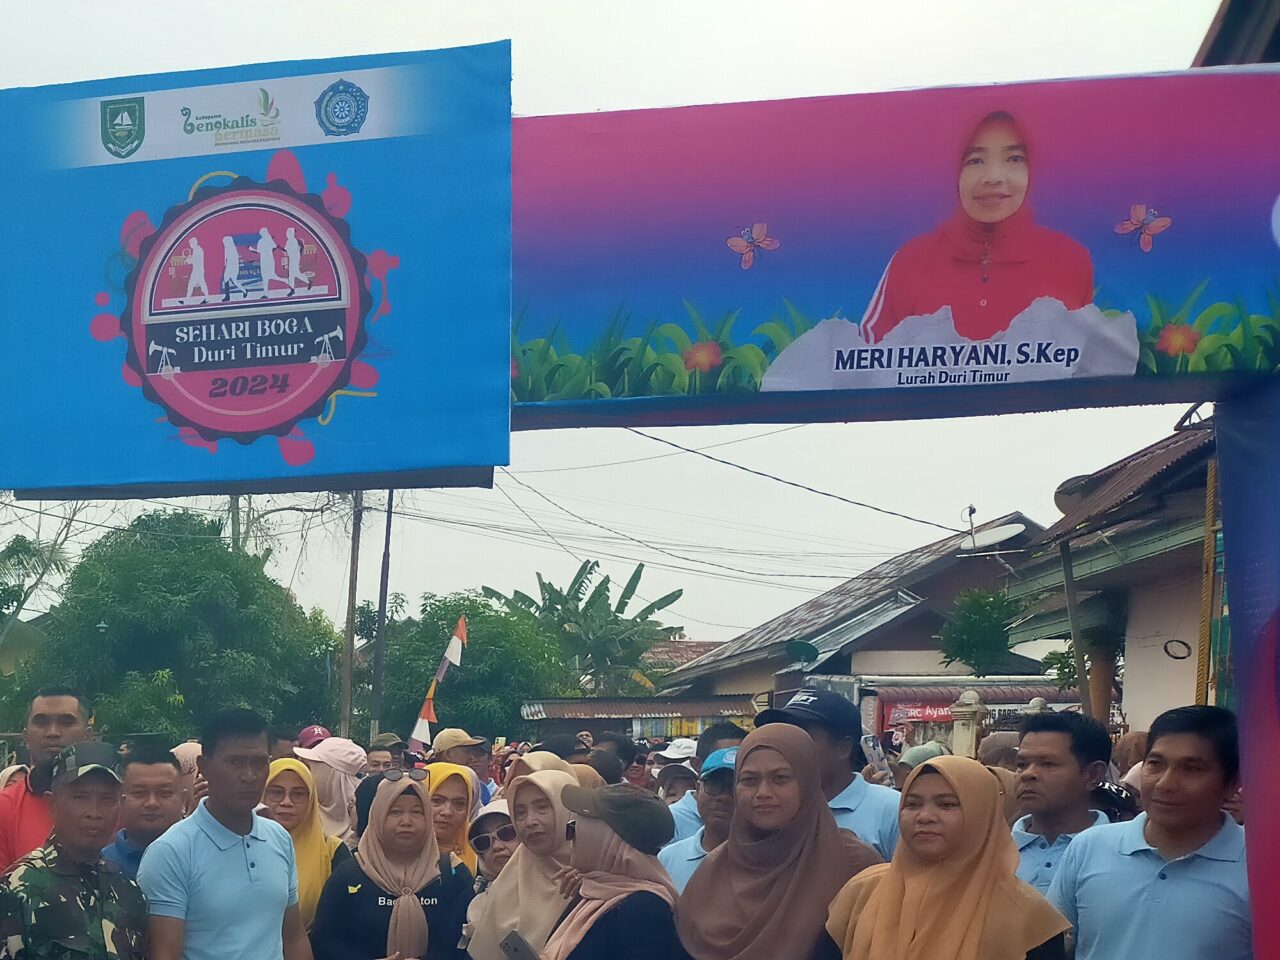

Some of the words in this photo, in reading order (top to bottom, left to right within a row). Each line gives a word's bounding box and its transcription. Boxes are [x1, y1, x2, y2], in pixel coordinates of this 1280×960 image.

[175, 321, 250, 343] SEHARI
[257, 316, 314, 337] BOGA
[193, 345, 236, 363] Duri
[241, 342, 305, 359] Timur
[834, 348, 893, 370] MERI
[897, 344, 1011, 368] HARYANI,
[1016, 342, 1080, 367] S.Kep
[209, 373, 290, 398] 2024
[897, 371, 935, 385] Lurah
[938, 370, 967, 384] Duri
[970, 369, 1010, 383] Timur
